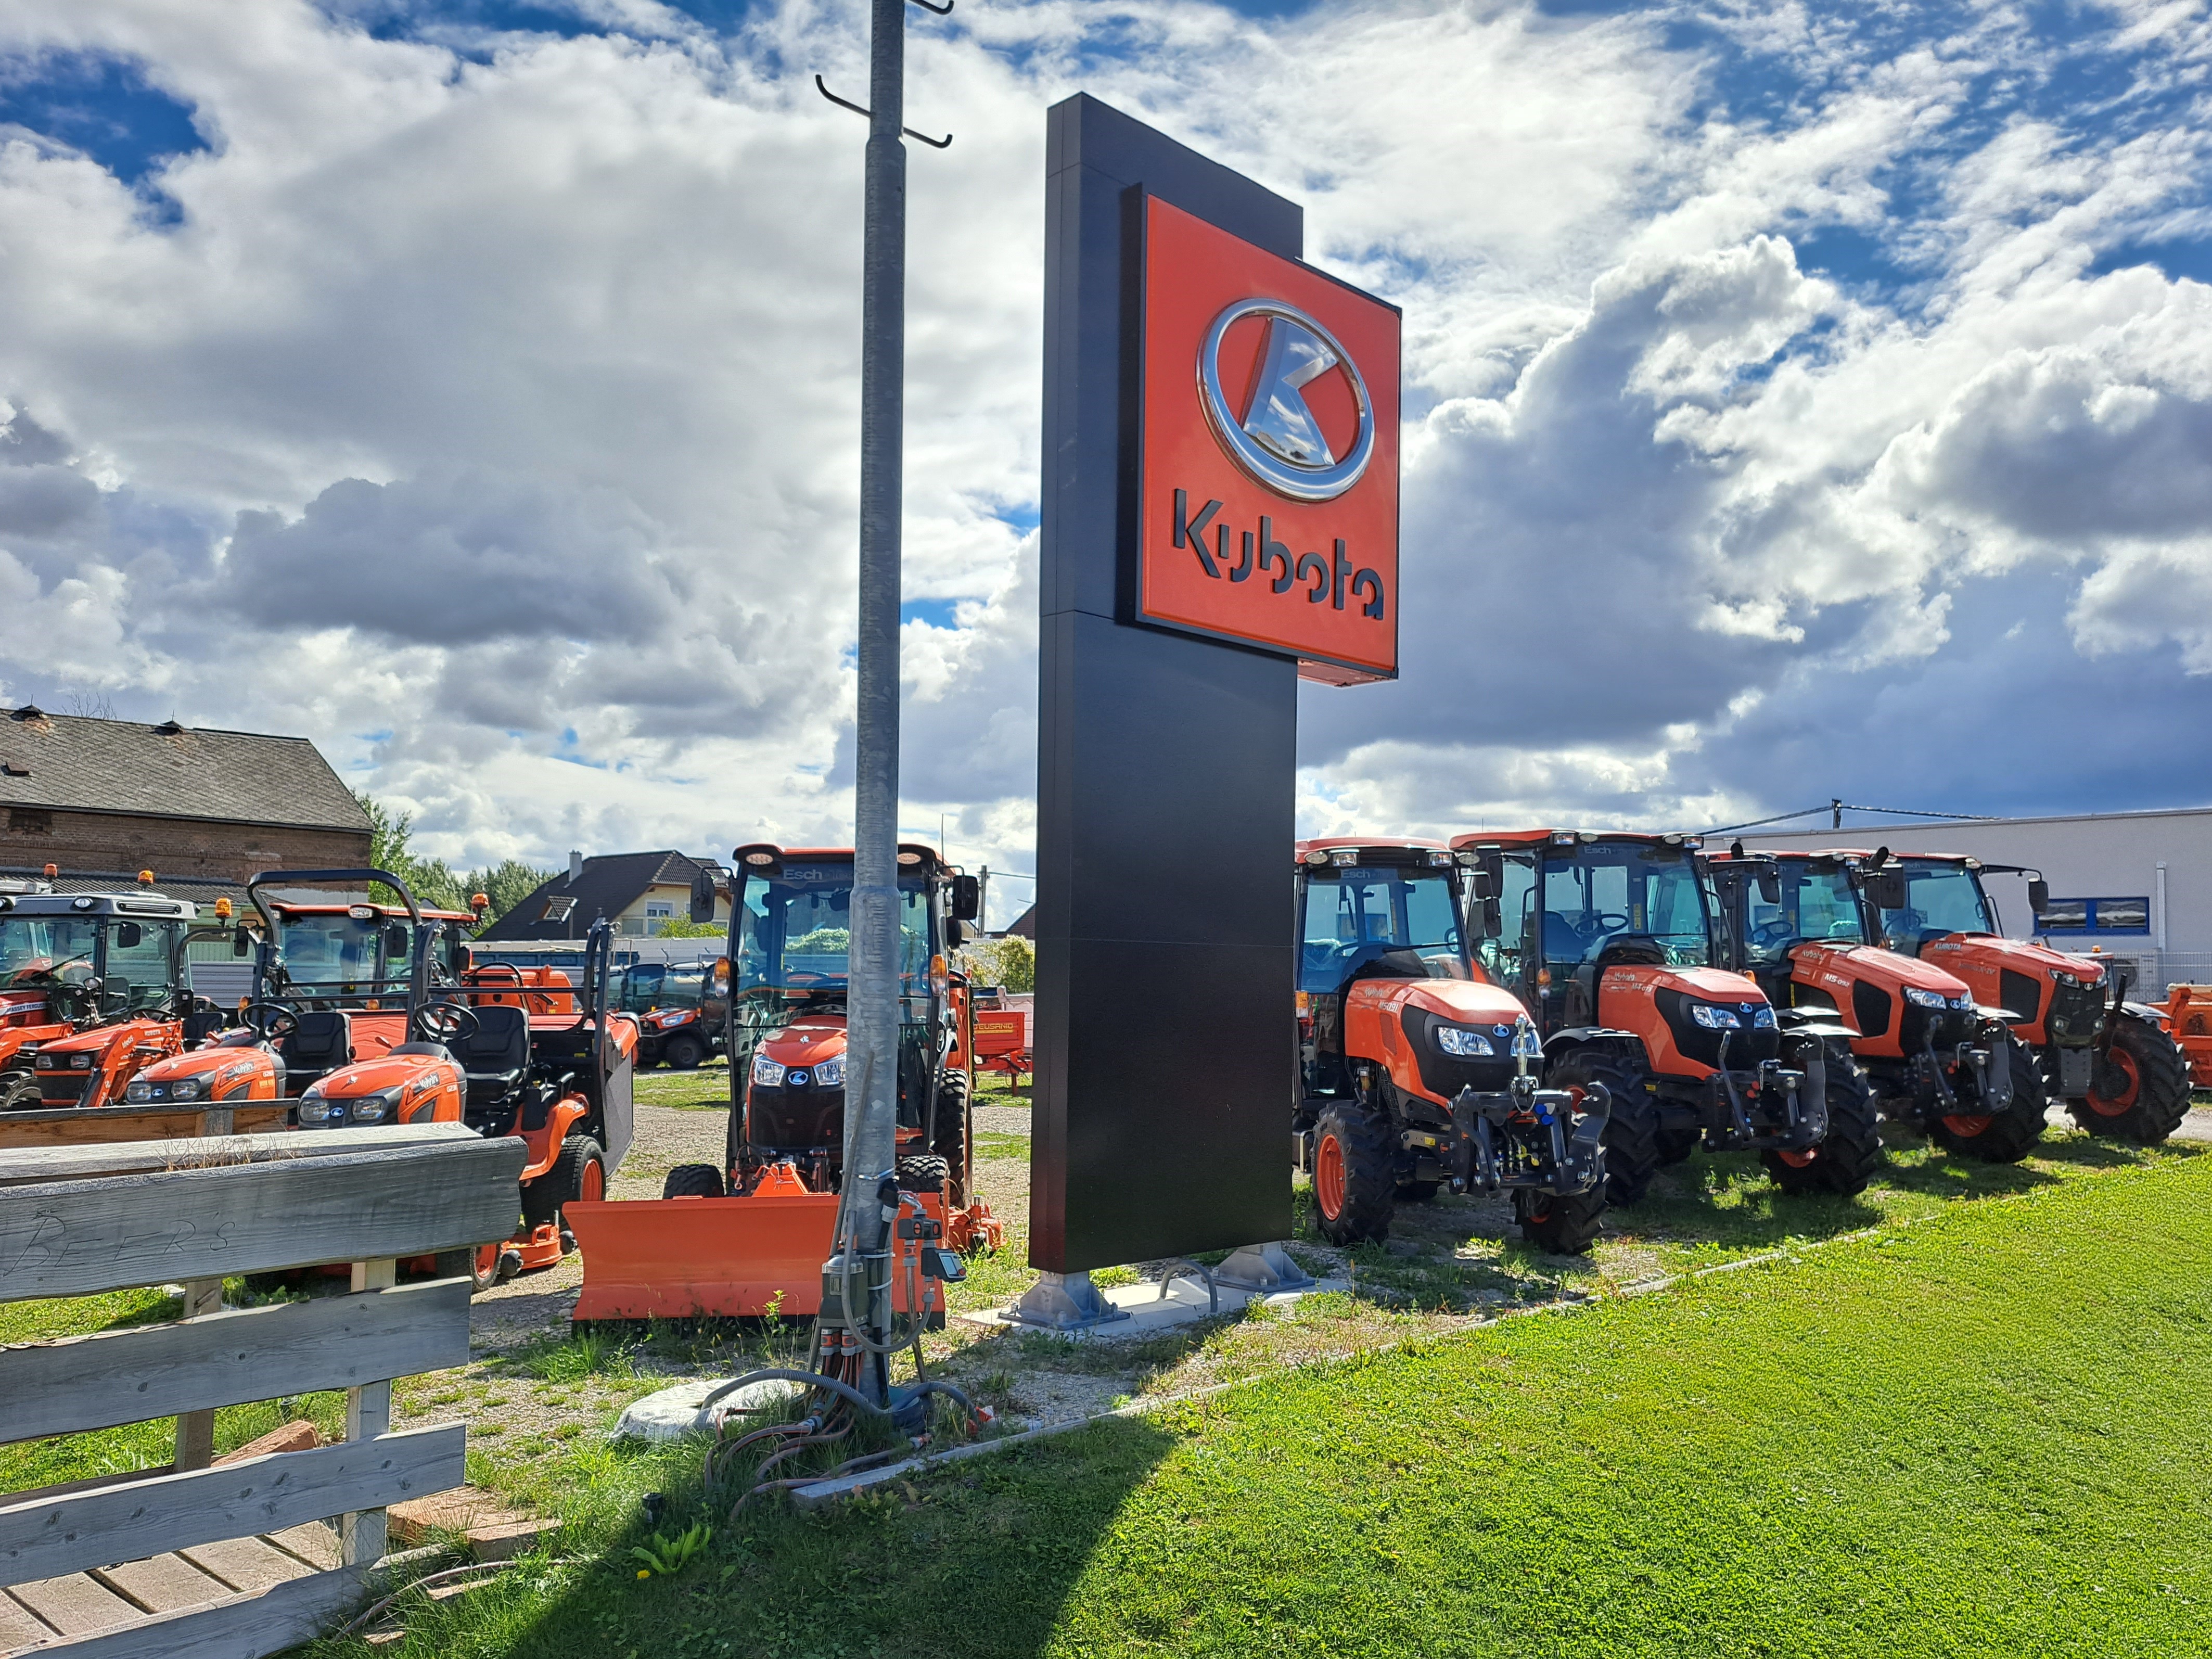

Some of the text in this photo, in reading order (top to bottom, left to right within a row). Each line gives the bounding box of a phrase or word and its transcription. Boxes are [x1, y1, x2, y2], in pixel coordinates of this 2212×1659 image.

[1173, 488, 1384, 620] Kubota
[1584, 846, 1611, 854] Esch
[783, 869, 822, 880] Esch
[1342, 870, 1370, 879] Esch
[6, 1004, 25, 1013] MASSEY
